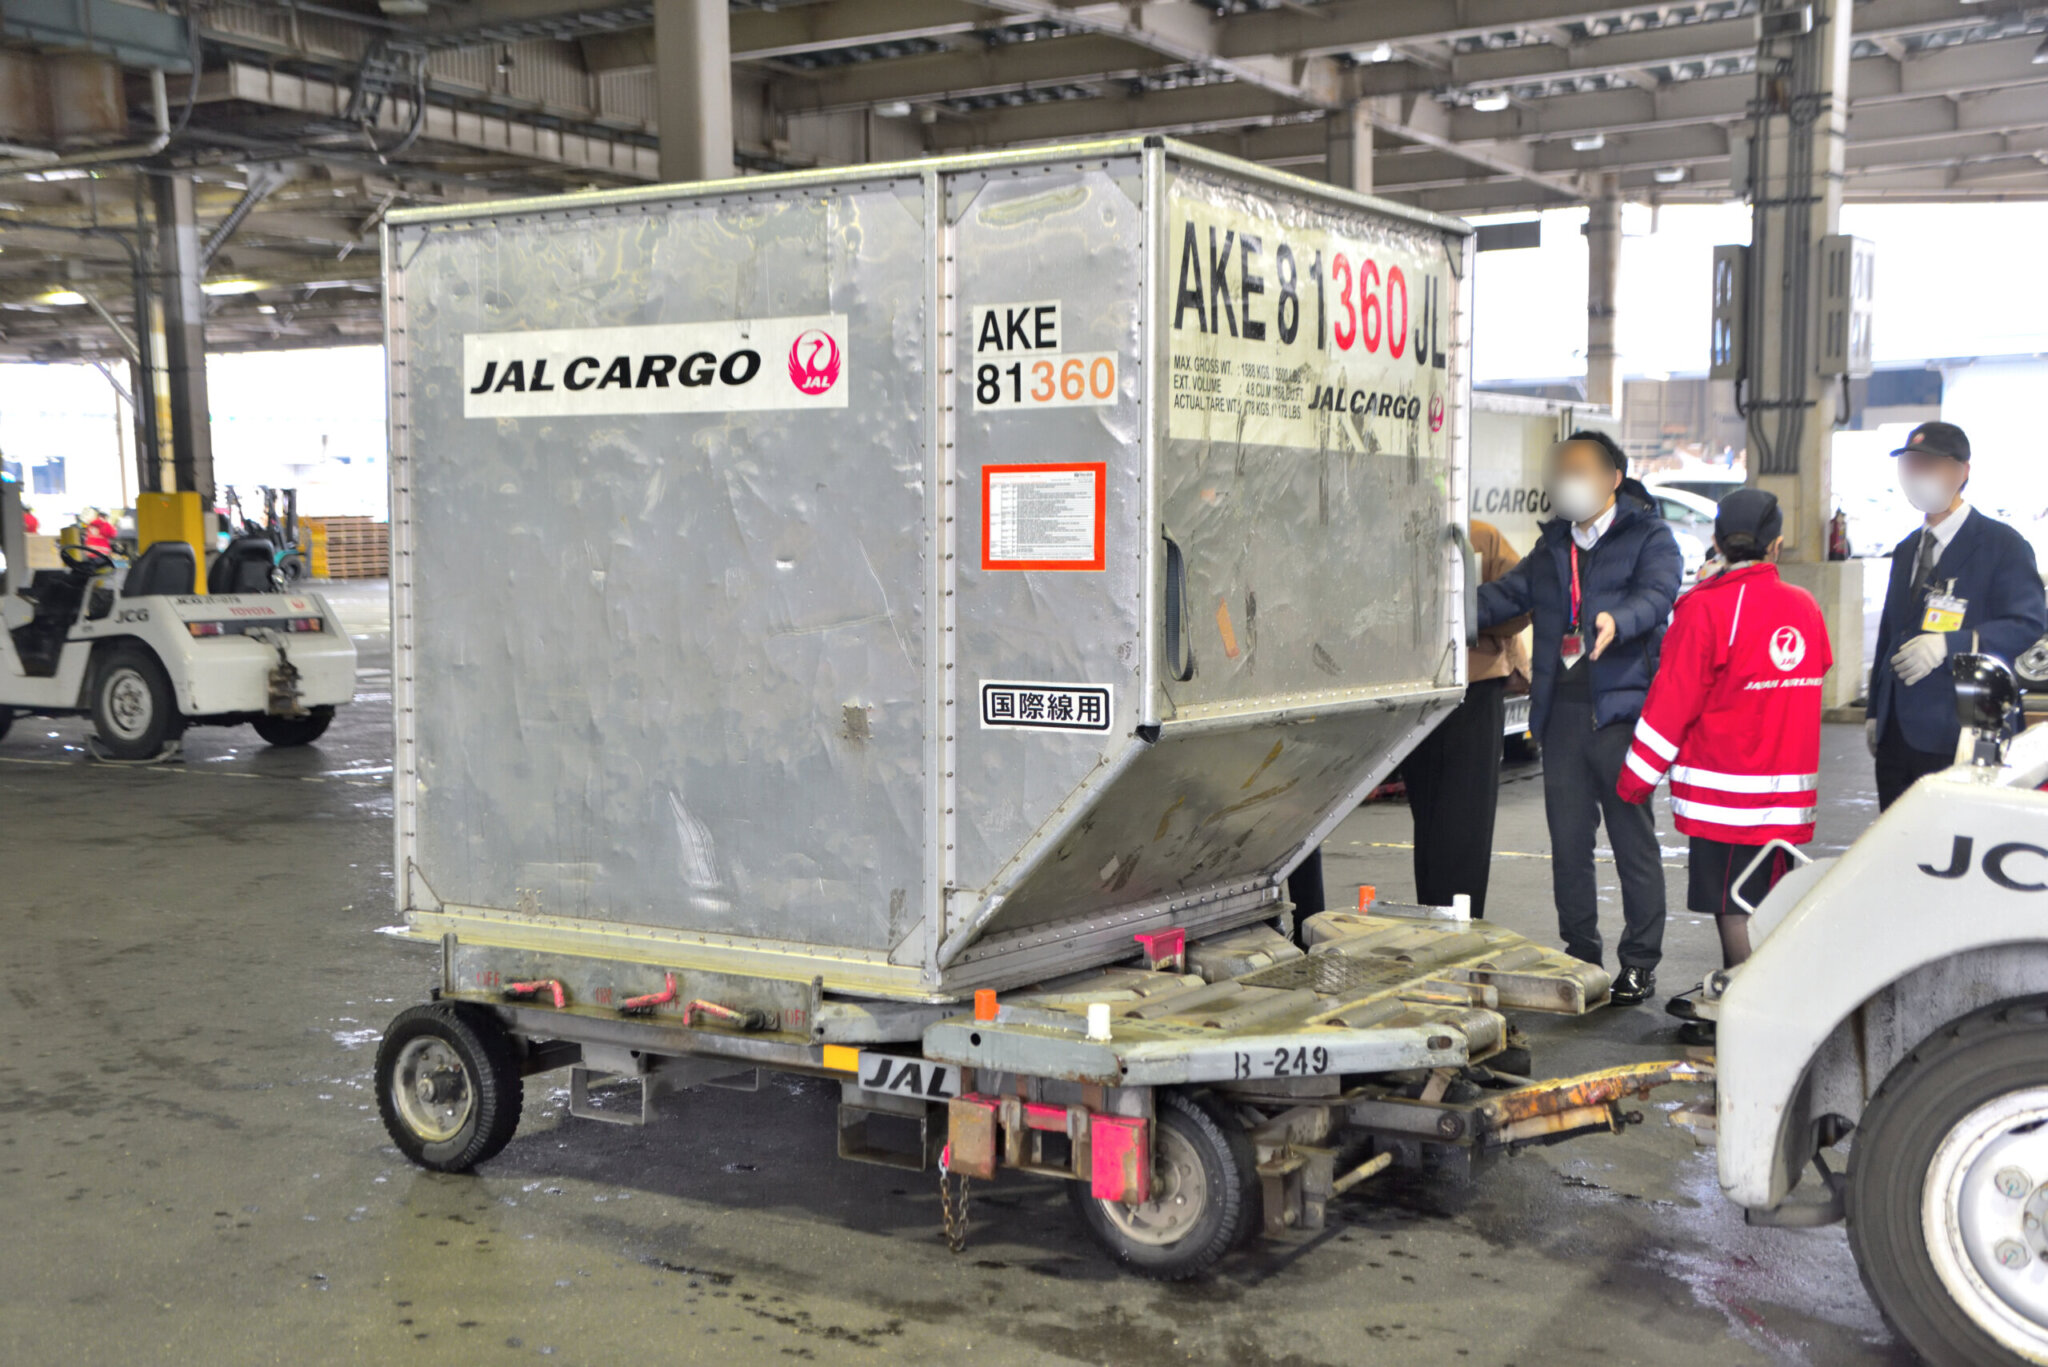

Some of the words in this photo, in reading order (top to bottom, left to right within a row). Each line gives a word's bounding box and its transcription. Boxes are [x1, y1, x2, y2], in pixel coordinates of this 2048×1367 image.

[1174, 220, 1266, 341] AKE
[1414, 273, 1446, 369] JL
[977, 305, 1057, 352] AKE
[1194, 357, 1219, 375] GROSS
[802, 375, 830, 388] JAL
[976, 356, 1115, 405] 81360
[1174, 374, 1191, 390] EXT.
[1193, 376, 1222, 393] VOLUME
[1174, 394, 1204, 410] ACTUAL
[1206, 396, 1225, 412] TARE
[115, 608, 149, 623] JCG
[230, 606, 275, 616] TOYOTA
[991, 692, 1101, 722] 国際線用
[863, 1058, 954, 1098] JAL
